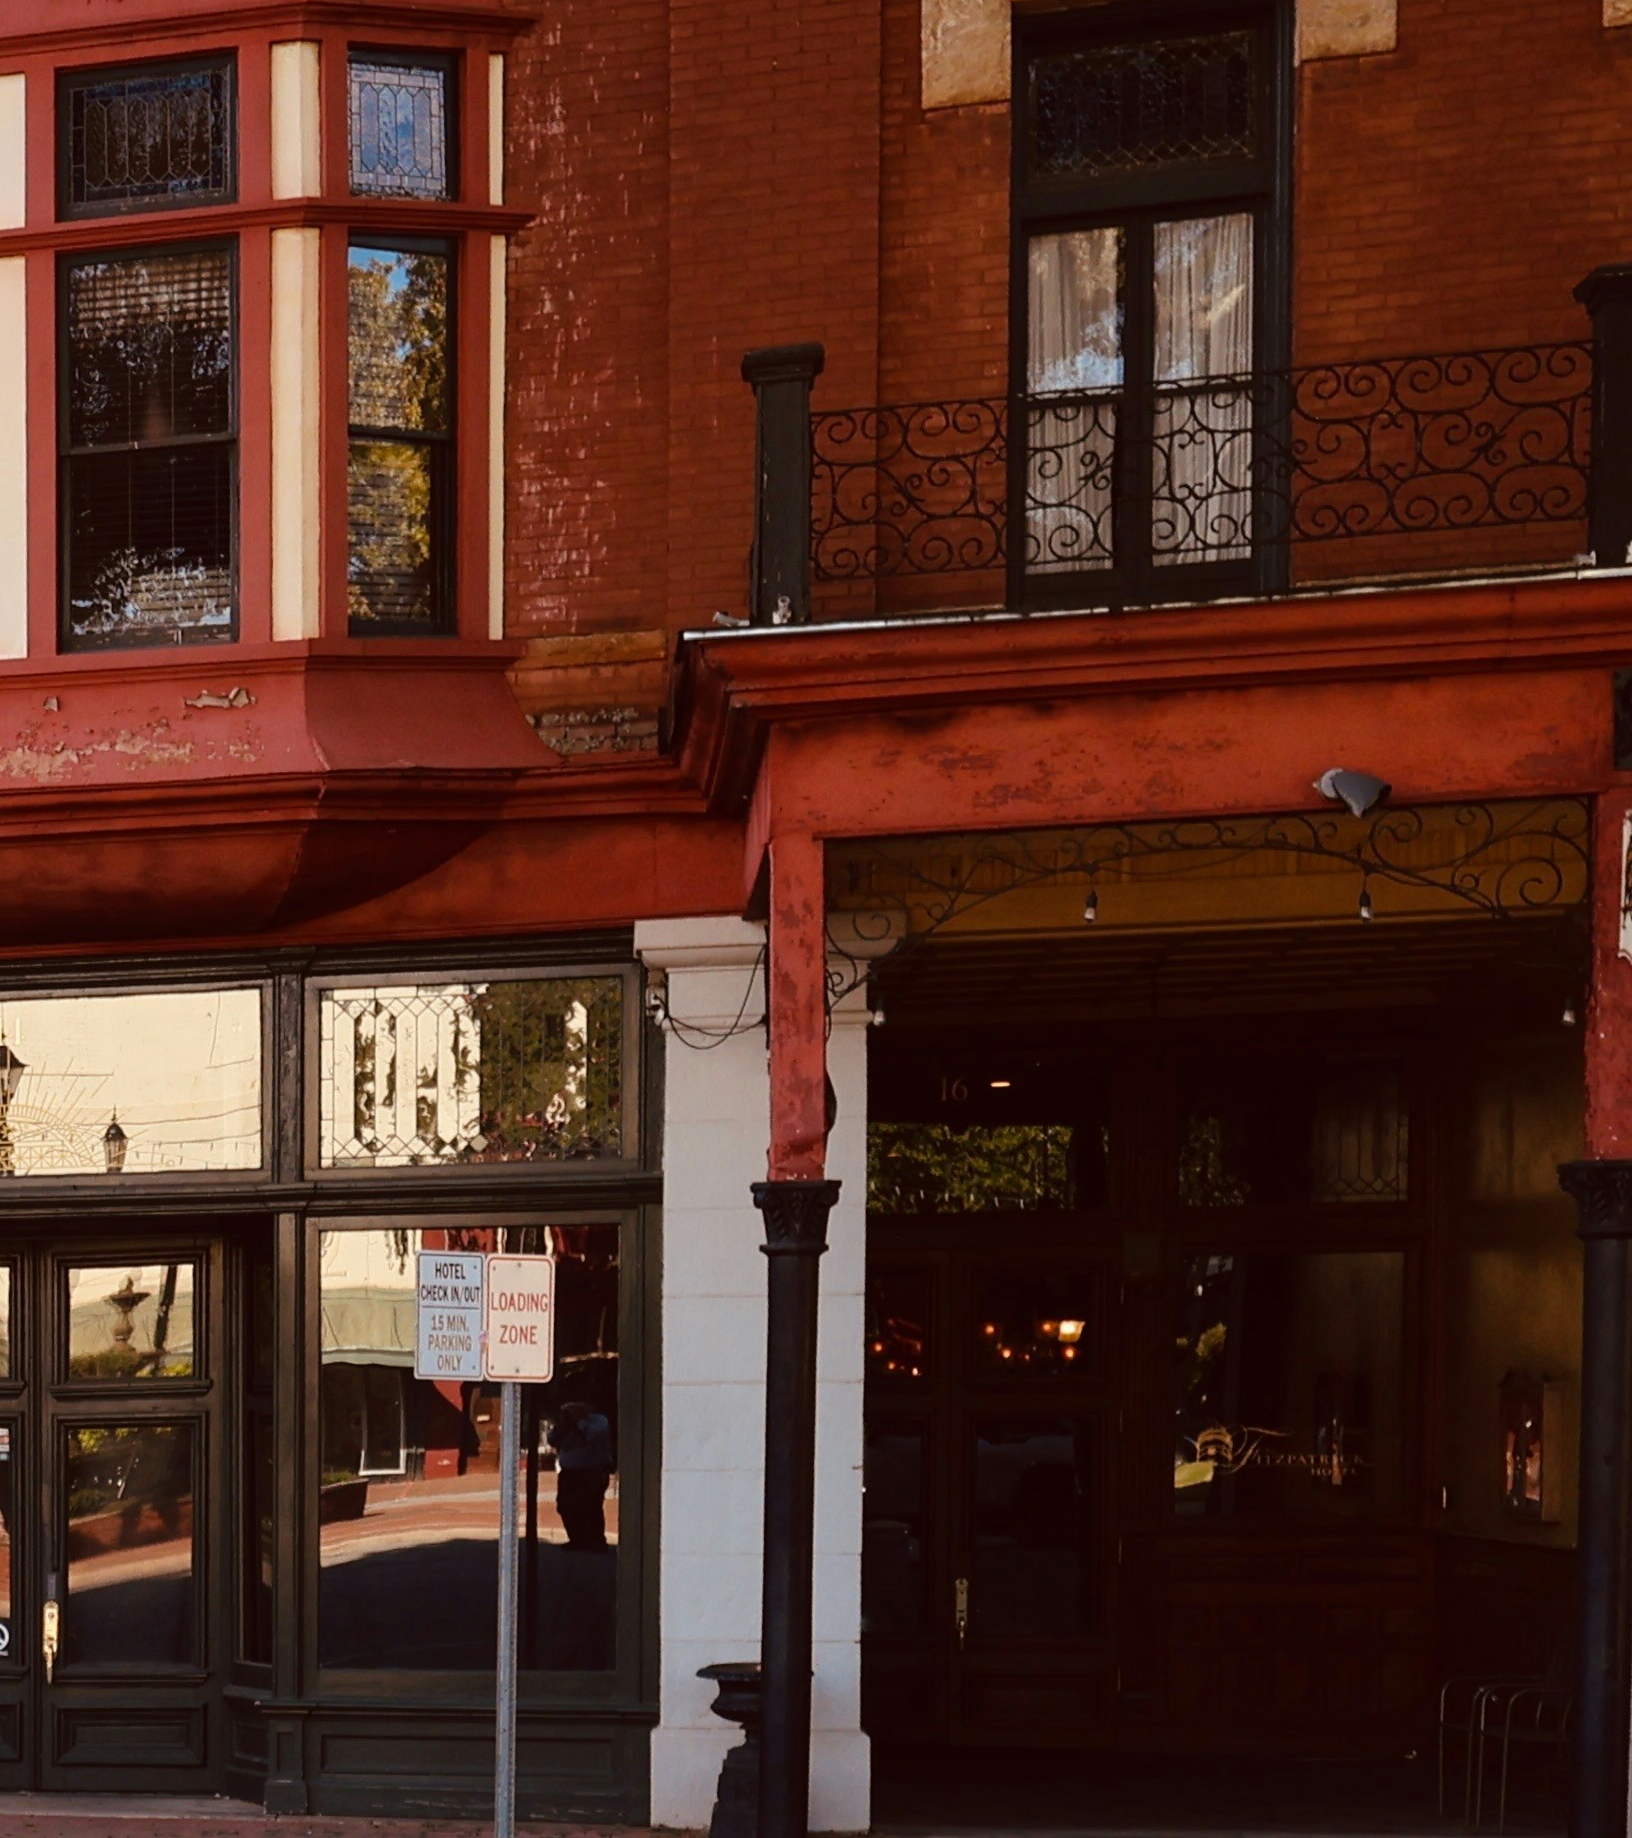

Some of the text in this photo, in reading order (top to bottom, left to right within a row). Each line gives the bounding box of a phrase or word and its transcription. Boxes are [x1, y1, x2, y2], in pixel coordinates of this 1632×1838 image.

[940, 1076, 969, 1102] 16
[435, 1262, 466, 1280] HOTEL
[421, 1285, 481, 1306] CHECK IN/OUT
[490, 1292, 549, 1313] LOADING
[431, 1315, 470, 1331] 15 MIN.
[428, 1335, 472, 1352] PARKING
[499, 1325, 538, 1345] ZONE
[437, 1354, 463, 1371] ONLY
